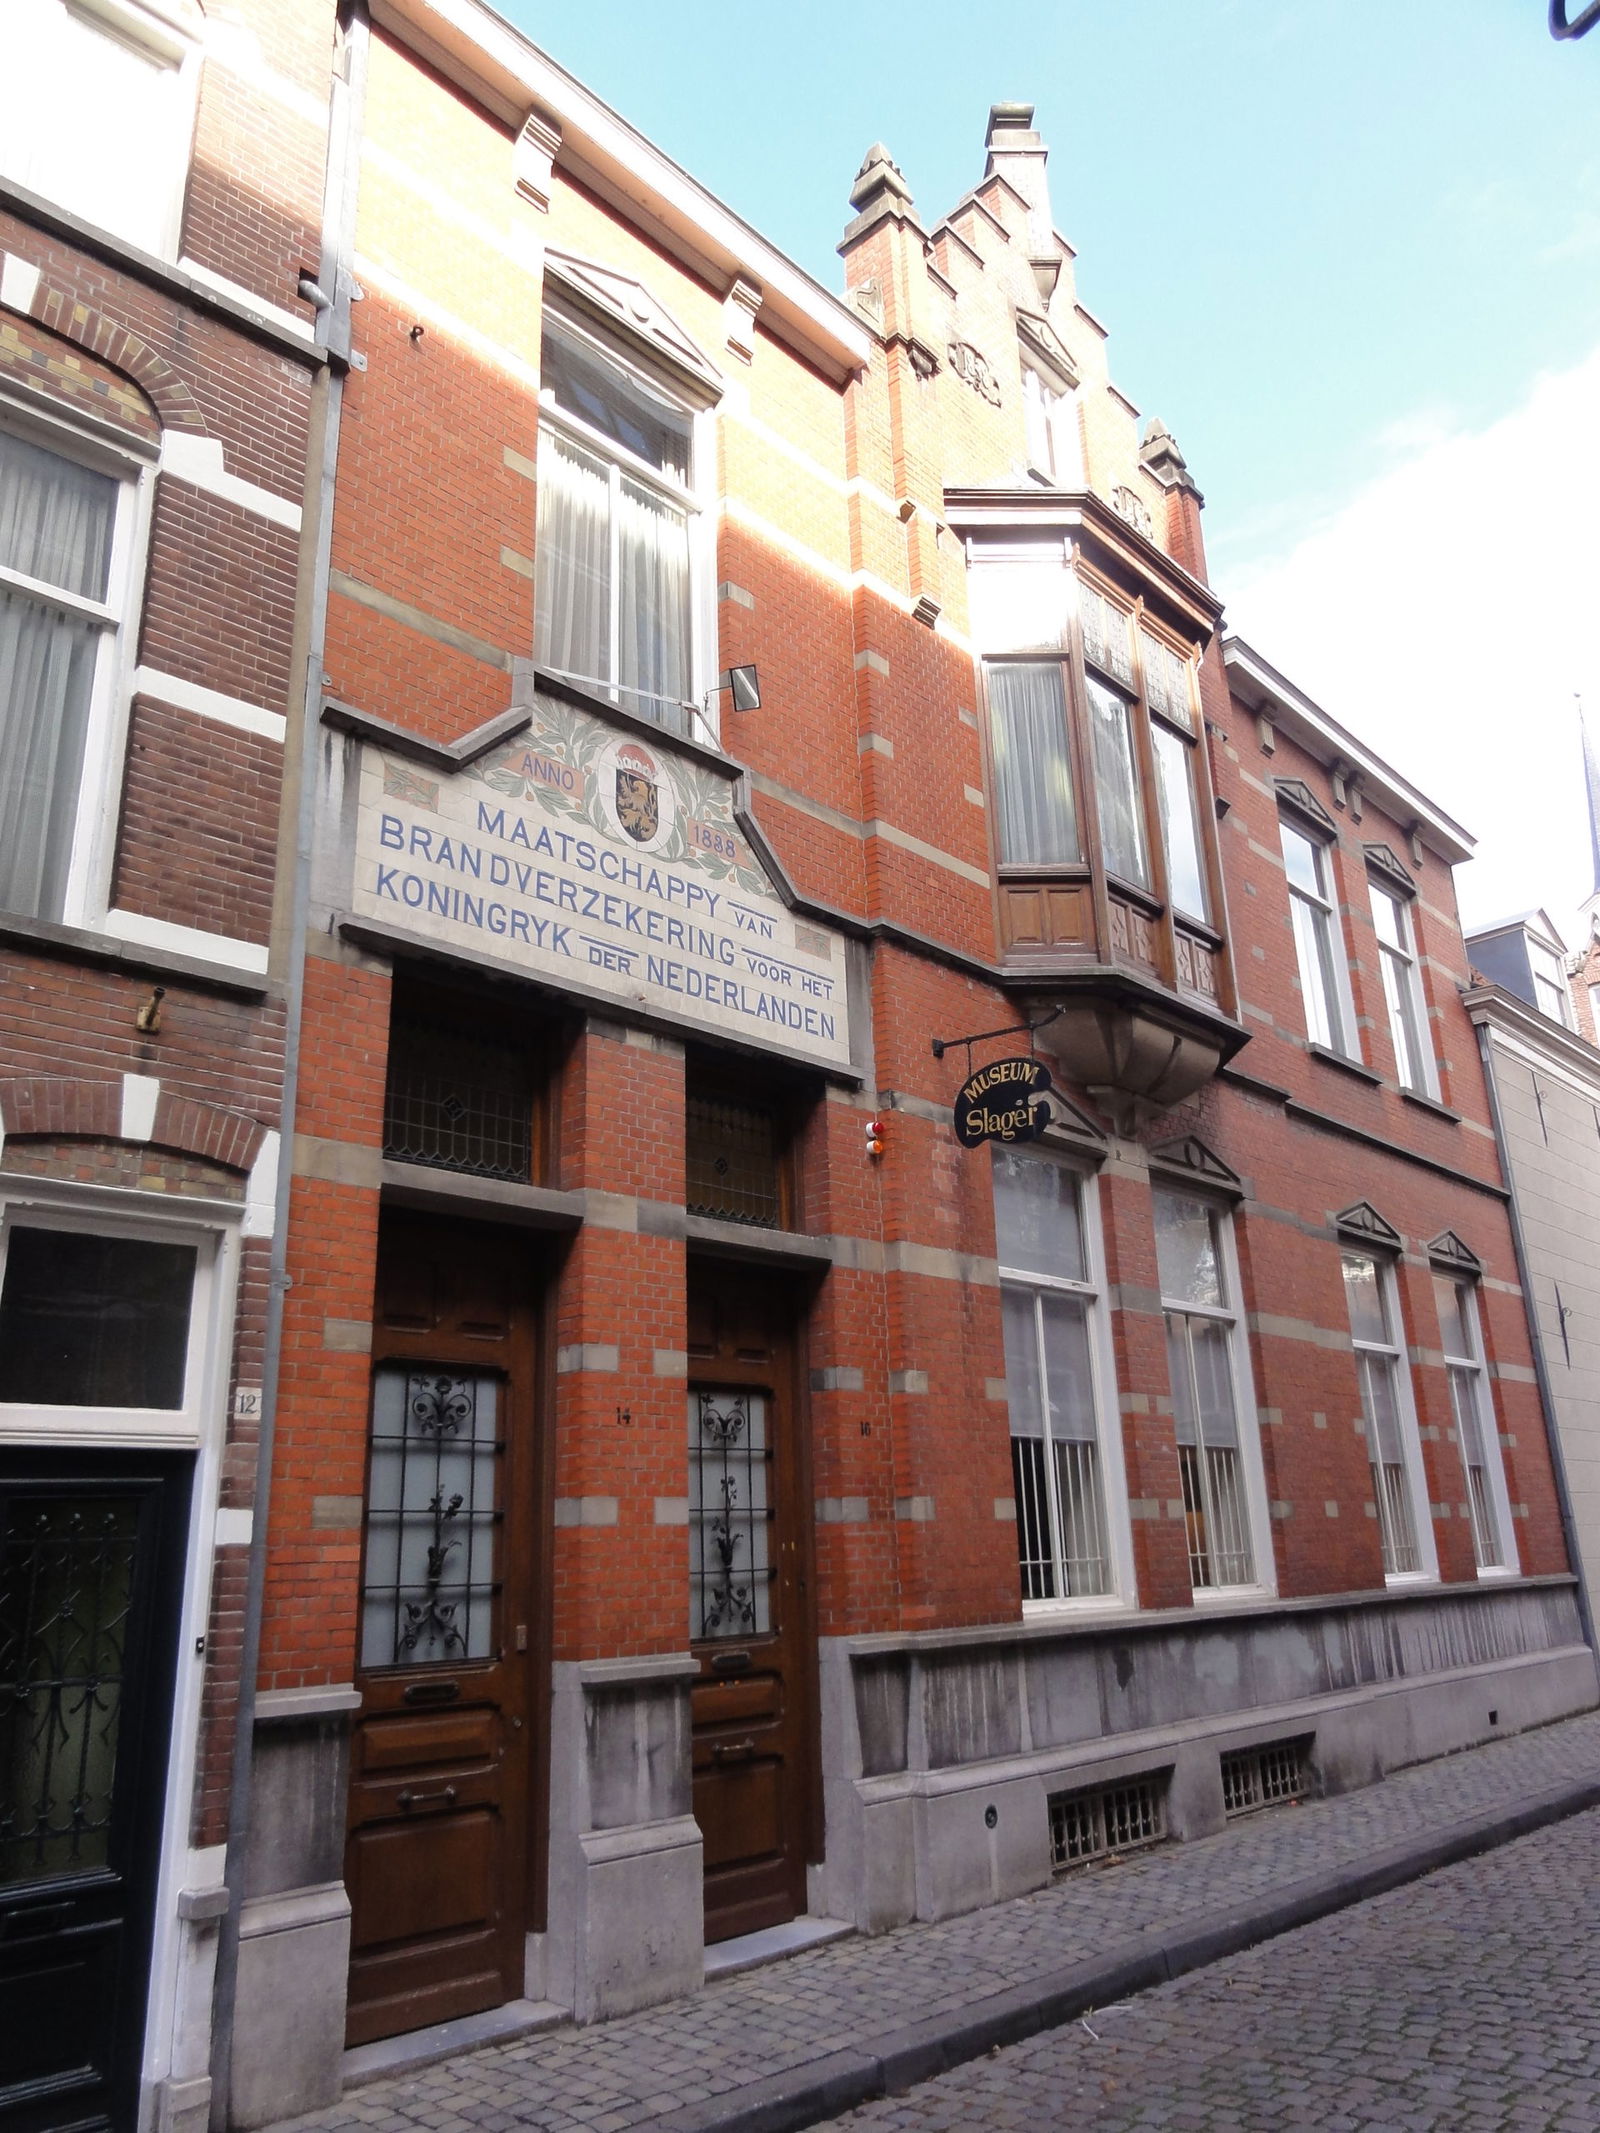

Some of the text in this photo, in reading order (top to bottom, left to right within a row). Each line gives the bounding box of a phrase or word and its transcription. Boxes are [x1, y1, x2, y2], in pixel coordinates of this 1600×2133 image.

[521, 753, 574, 790] ANNO
[477, 801, 773, 939] MAATSCHAPPY VAN
[380, 814, 833, 1000] BRANDVERZEKERING VOOR HET
[376, 864, 835, 1040] KONINGRYK DER NEDERLANDEN
[963, 1062, 1040, 1104] MUSEUM
[966, 1106, 1038, 1141] Slager
[240, 1394, 257, 1414] 12
[616, 1406, 631, 1425] 14
